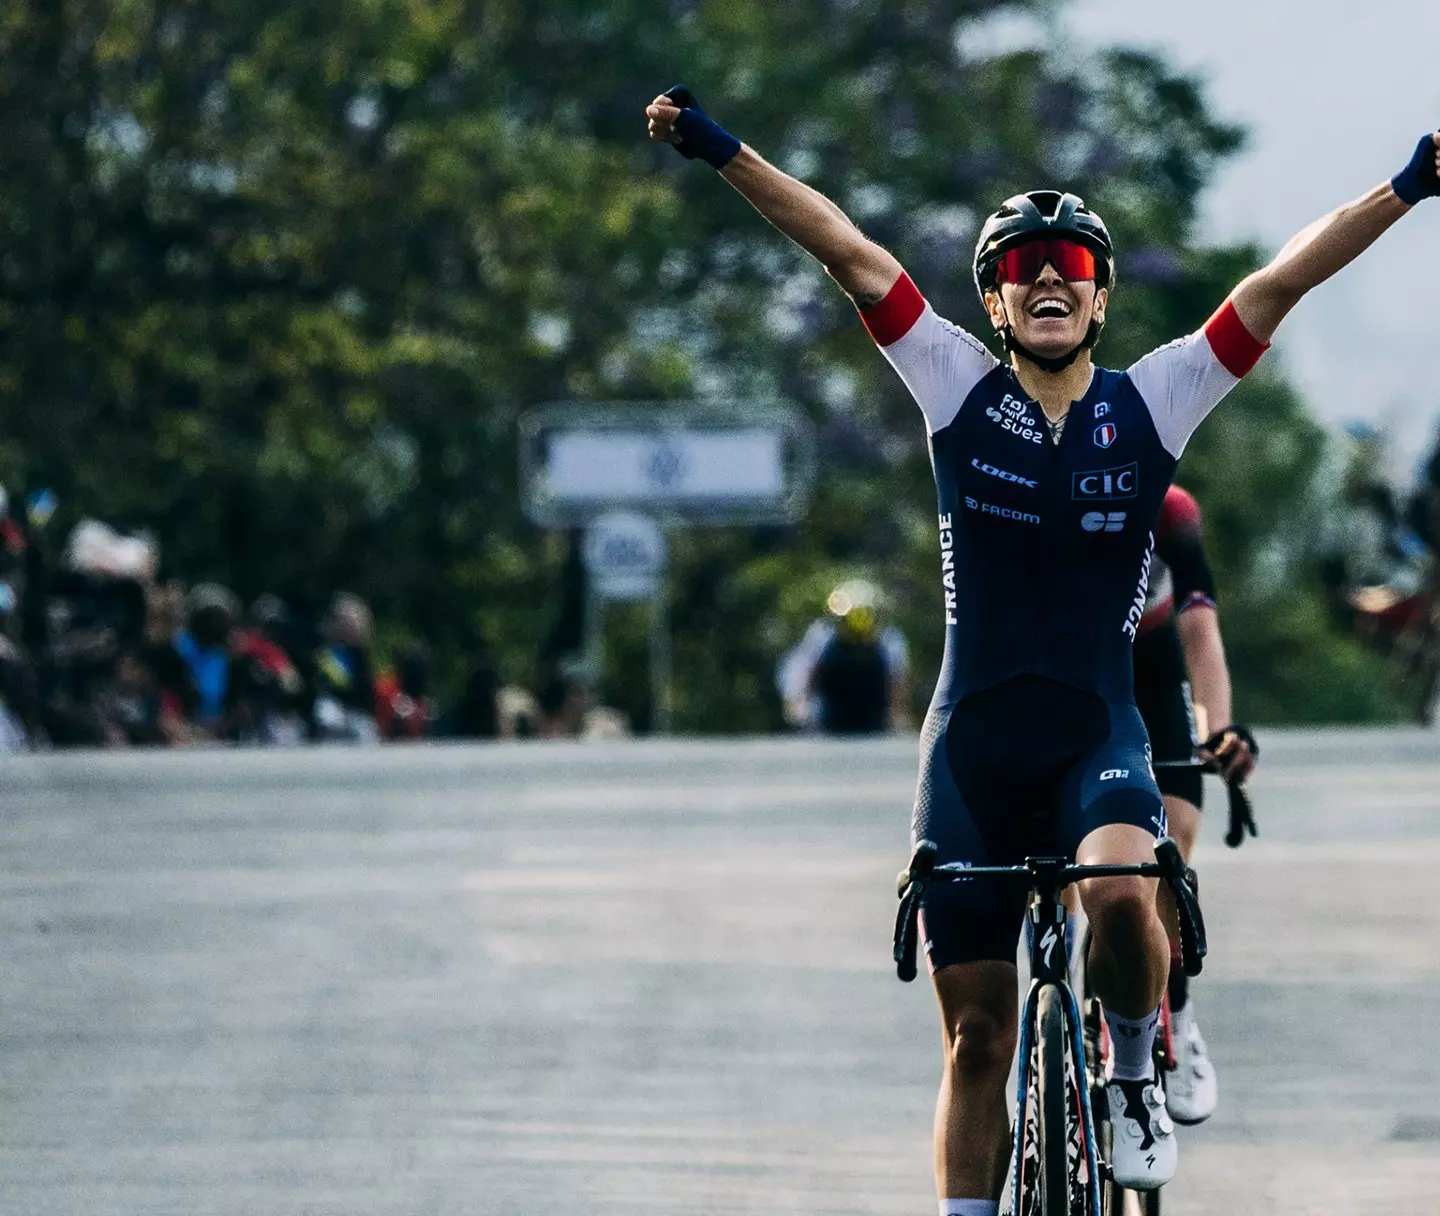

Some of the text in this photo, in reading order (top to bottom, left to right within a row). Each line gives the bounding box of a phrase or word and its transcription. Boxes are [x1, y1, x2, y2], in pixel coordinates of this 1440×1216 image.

[1000, 402, 1036, 427] UNITED
[971, 458, 1039, 488] LOOK
[1079, 471, 1133, 495] CIC
[938, 512, 958, 626] FRANCE
